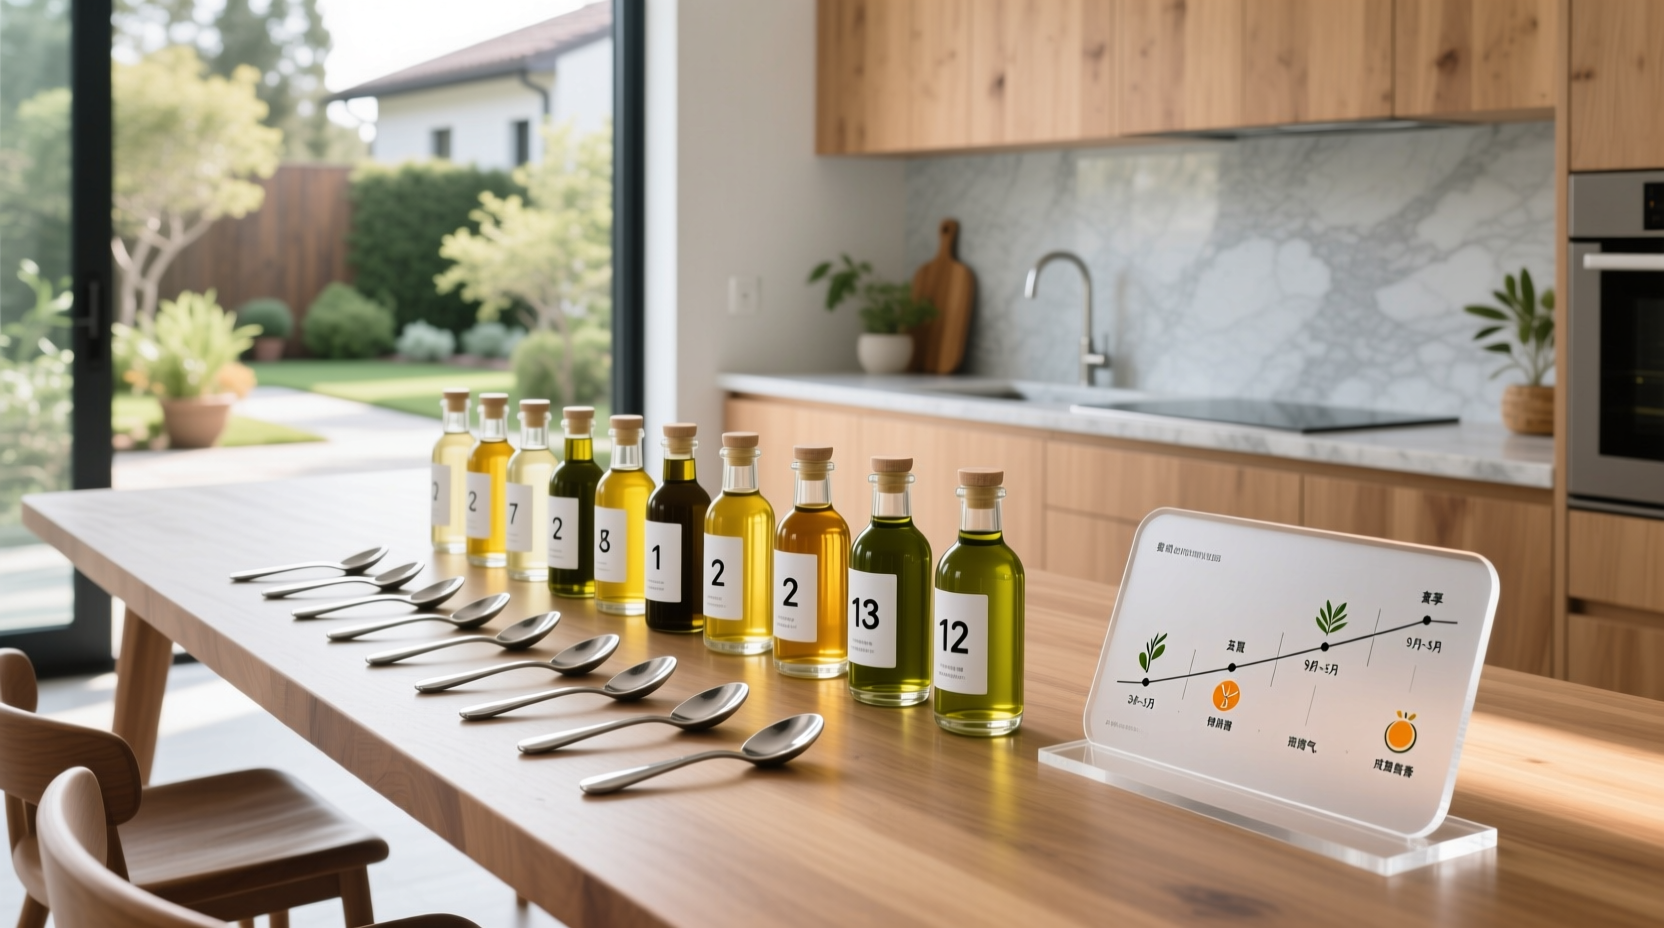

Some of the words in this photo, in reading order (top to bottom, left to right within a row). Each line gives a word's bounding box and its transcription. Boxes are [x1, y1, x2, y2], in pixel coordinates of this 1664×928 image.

[468, 490, 477, 512] 2
[509, 503, 519, 524] 7
[553, 516, 563, 540] 2
[599, 529, 611, 553] 8
[651, 545, 661, 570] 1
[711, 558, 726, 587] 2
[782, 577, 799, 608] 2
[852, 597, 880, 630] 13
[939, 619, 969, 655] 12
